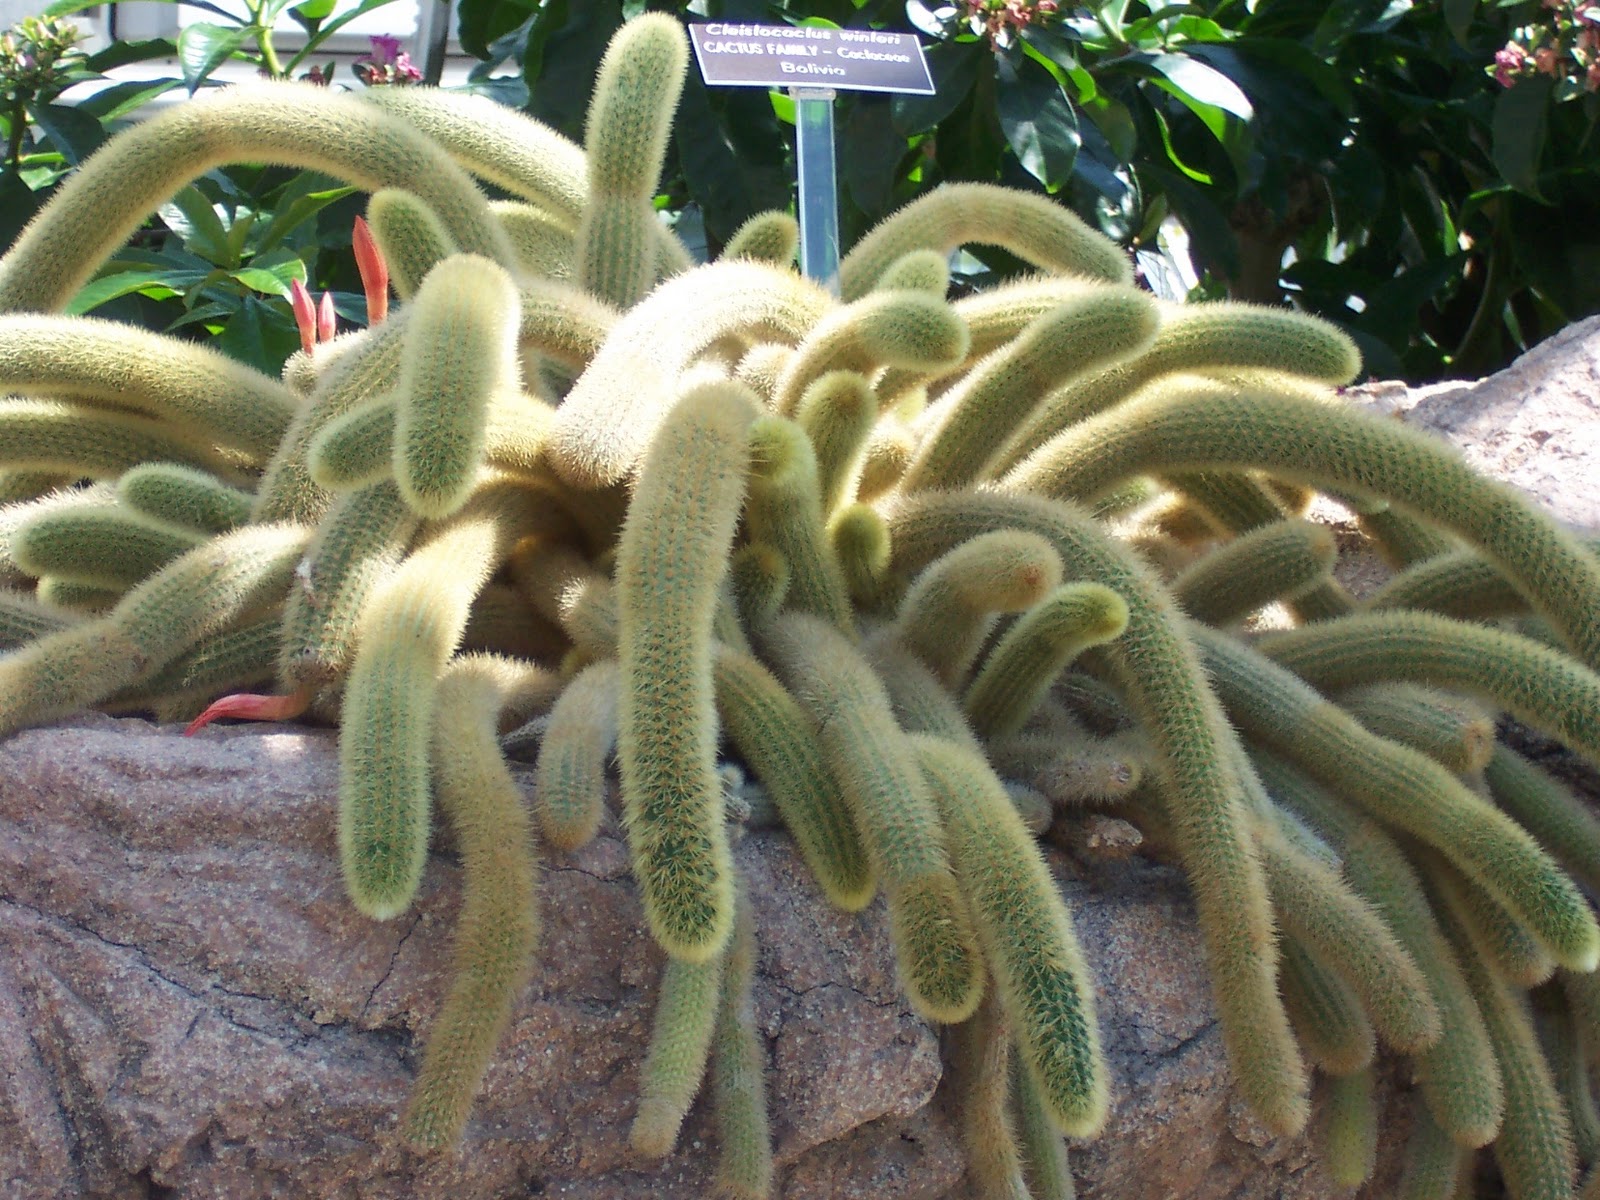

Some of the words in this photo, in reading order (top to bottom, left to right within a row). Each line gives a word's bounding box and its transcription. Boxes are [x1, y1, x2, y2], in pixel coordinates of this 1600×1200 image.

[703, 41, 764, 55] CACTUS
[767, 43, 818, 57] FAMILY
[780, 61, 846, 76] Bolivia
